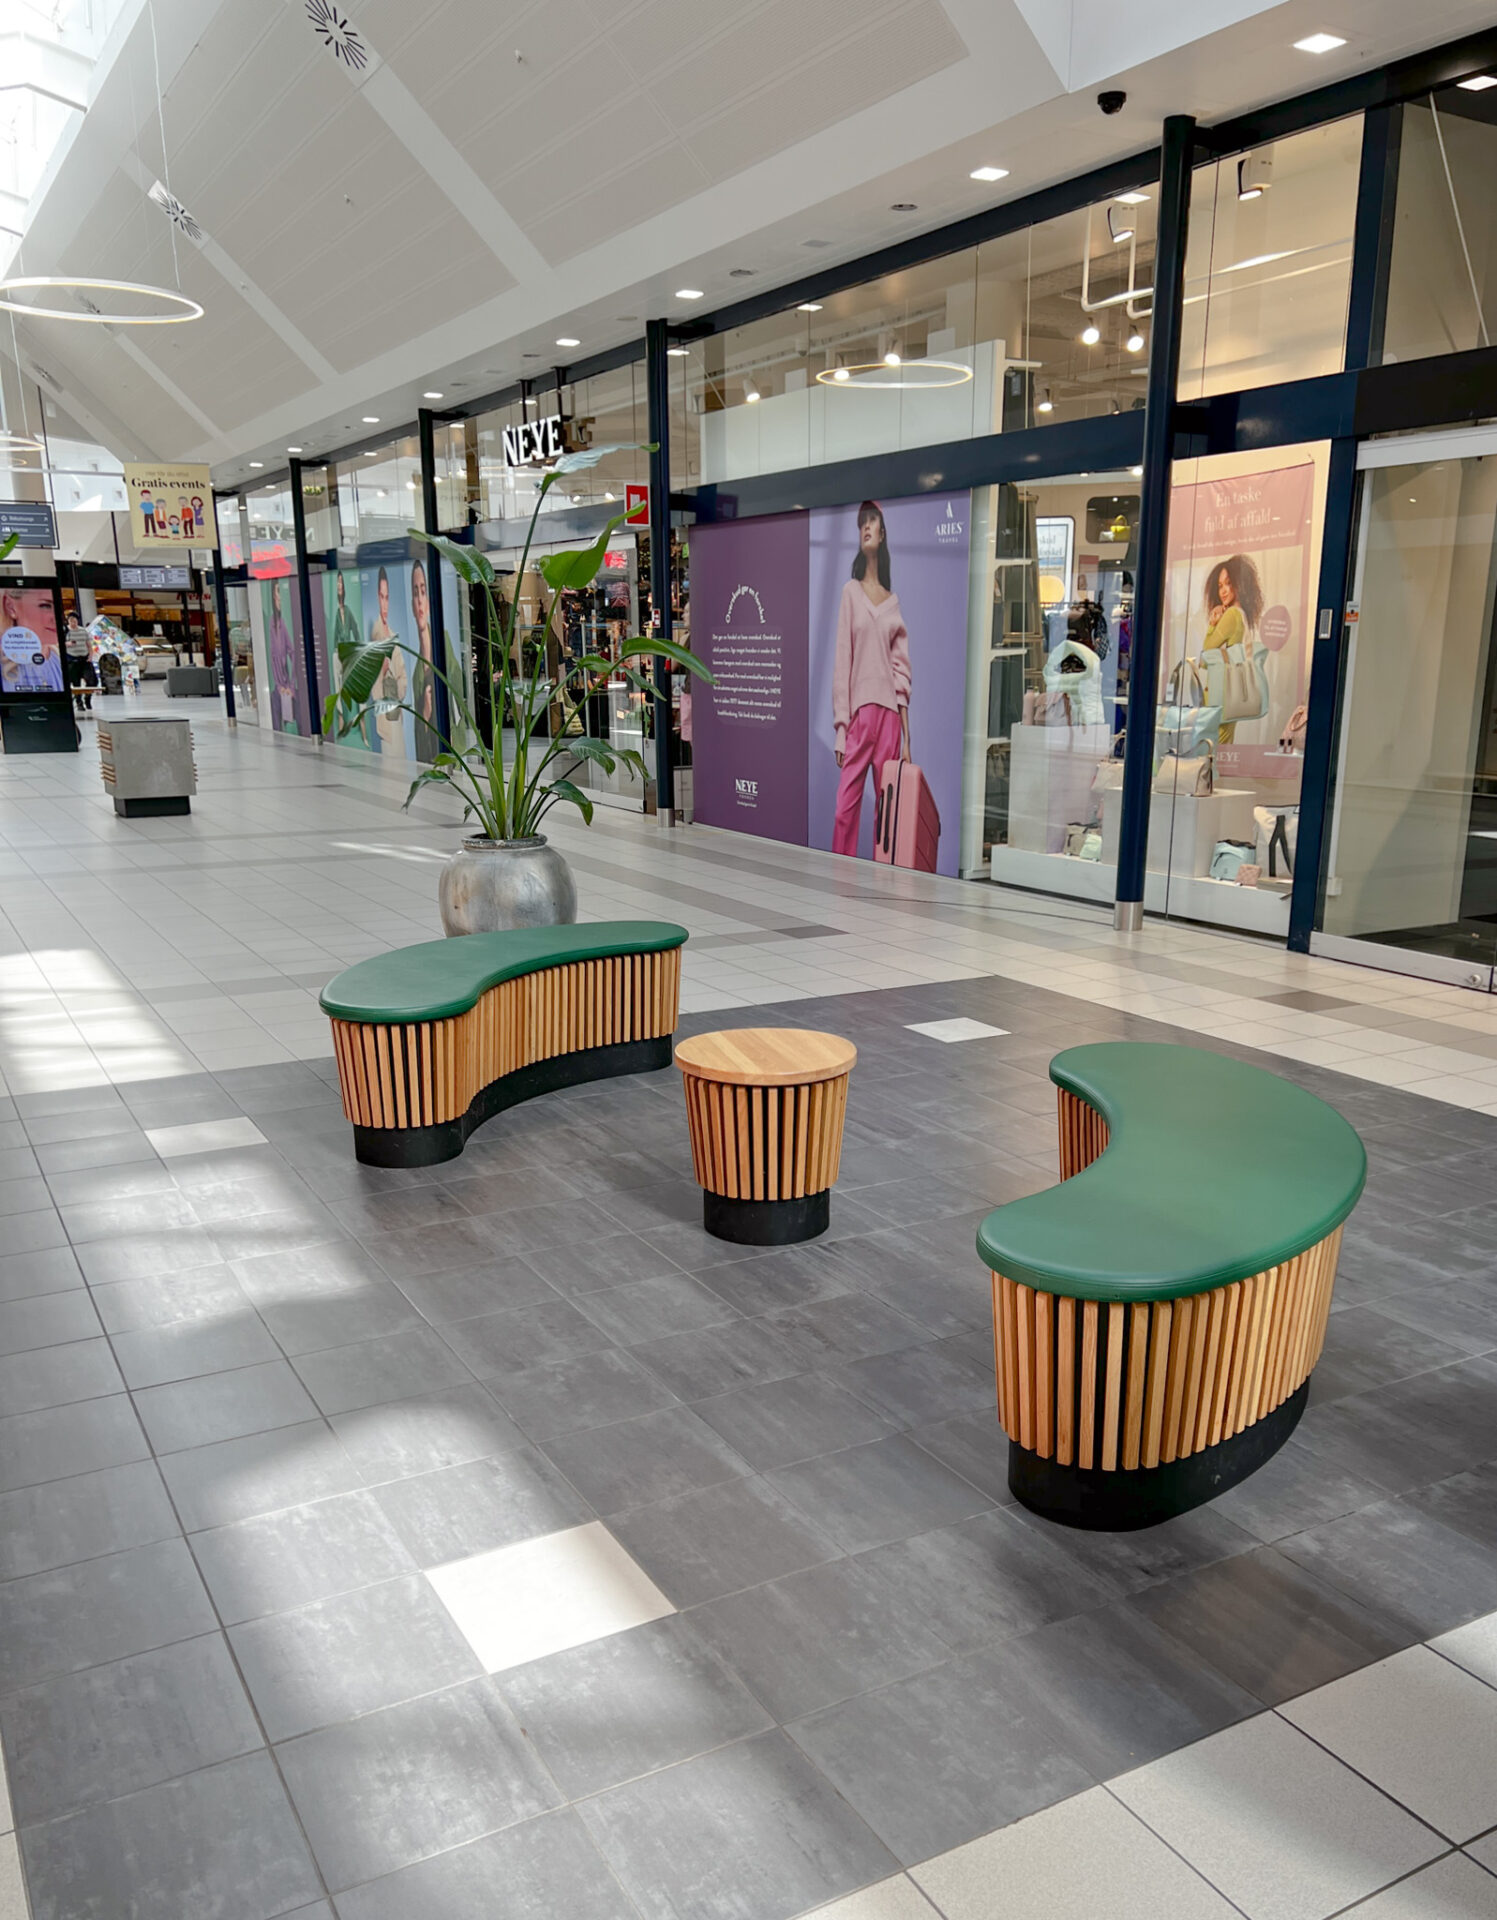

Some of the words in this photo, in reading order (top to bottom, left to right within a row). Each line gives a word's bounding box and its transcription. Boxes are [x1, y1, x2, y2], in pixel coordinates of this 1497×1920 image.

[502, 414, 564, 467] NEYE
[131, 477, 168, 488] Gratis
[169, 480, 206, 489] events
[1216, 491, 1231, 508] En
[936, 522, 964, 536] ARIES
[735, 779, 758, 794] NEYE
